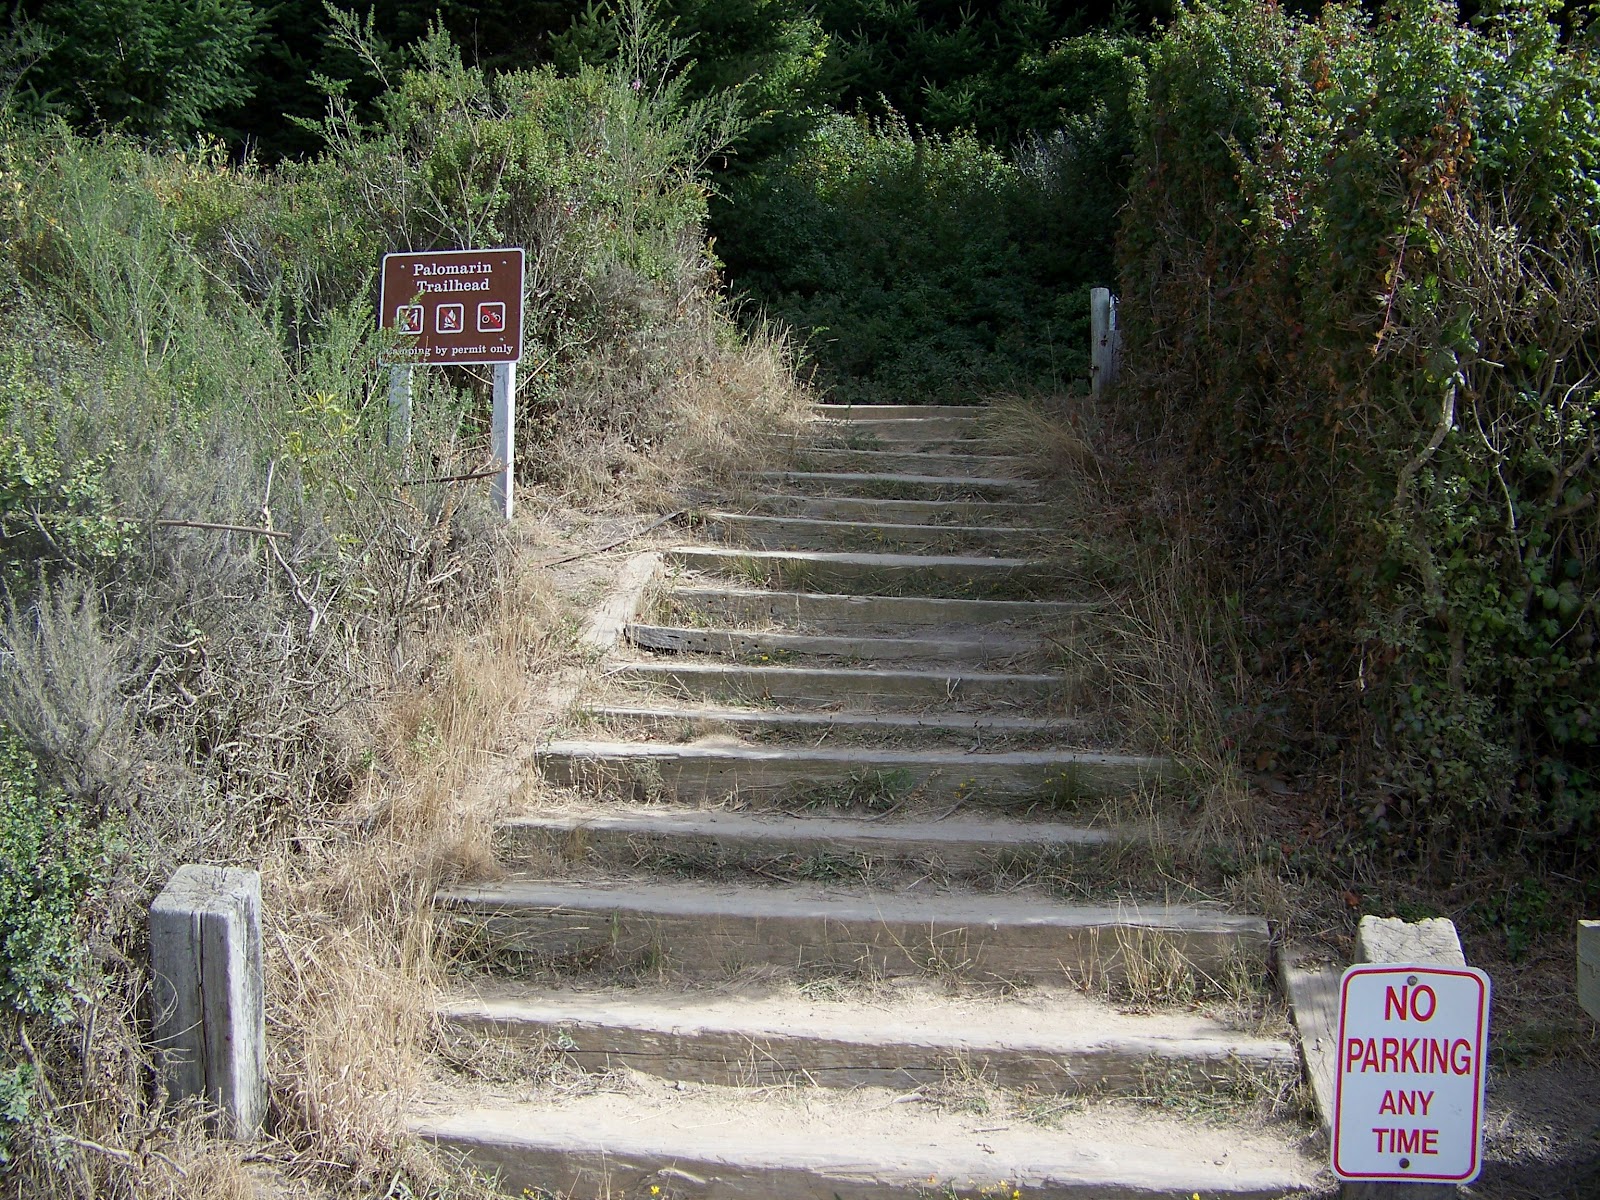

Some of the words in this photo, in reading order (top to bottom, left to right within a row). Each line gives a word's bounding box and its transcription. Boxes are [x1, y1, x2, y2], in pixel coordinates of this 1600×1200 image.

[413, 262, 493, 276] Palomarin
[416, 278, 490, 293] Trailhead
[386, 347, 432, 357] amping
[435, 346, 448, 356] by
[451, 345, 487, 356] permit
[490, 344, 514, 354] only
[1384, 984, 1437, 1022] NO
[1346, 1037, 1472, 1076] PARKING
[1378, 1089, 1435, 1116] ANY
[1372, 1128, 1439, 1155] TIME
